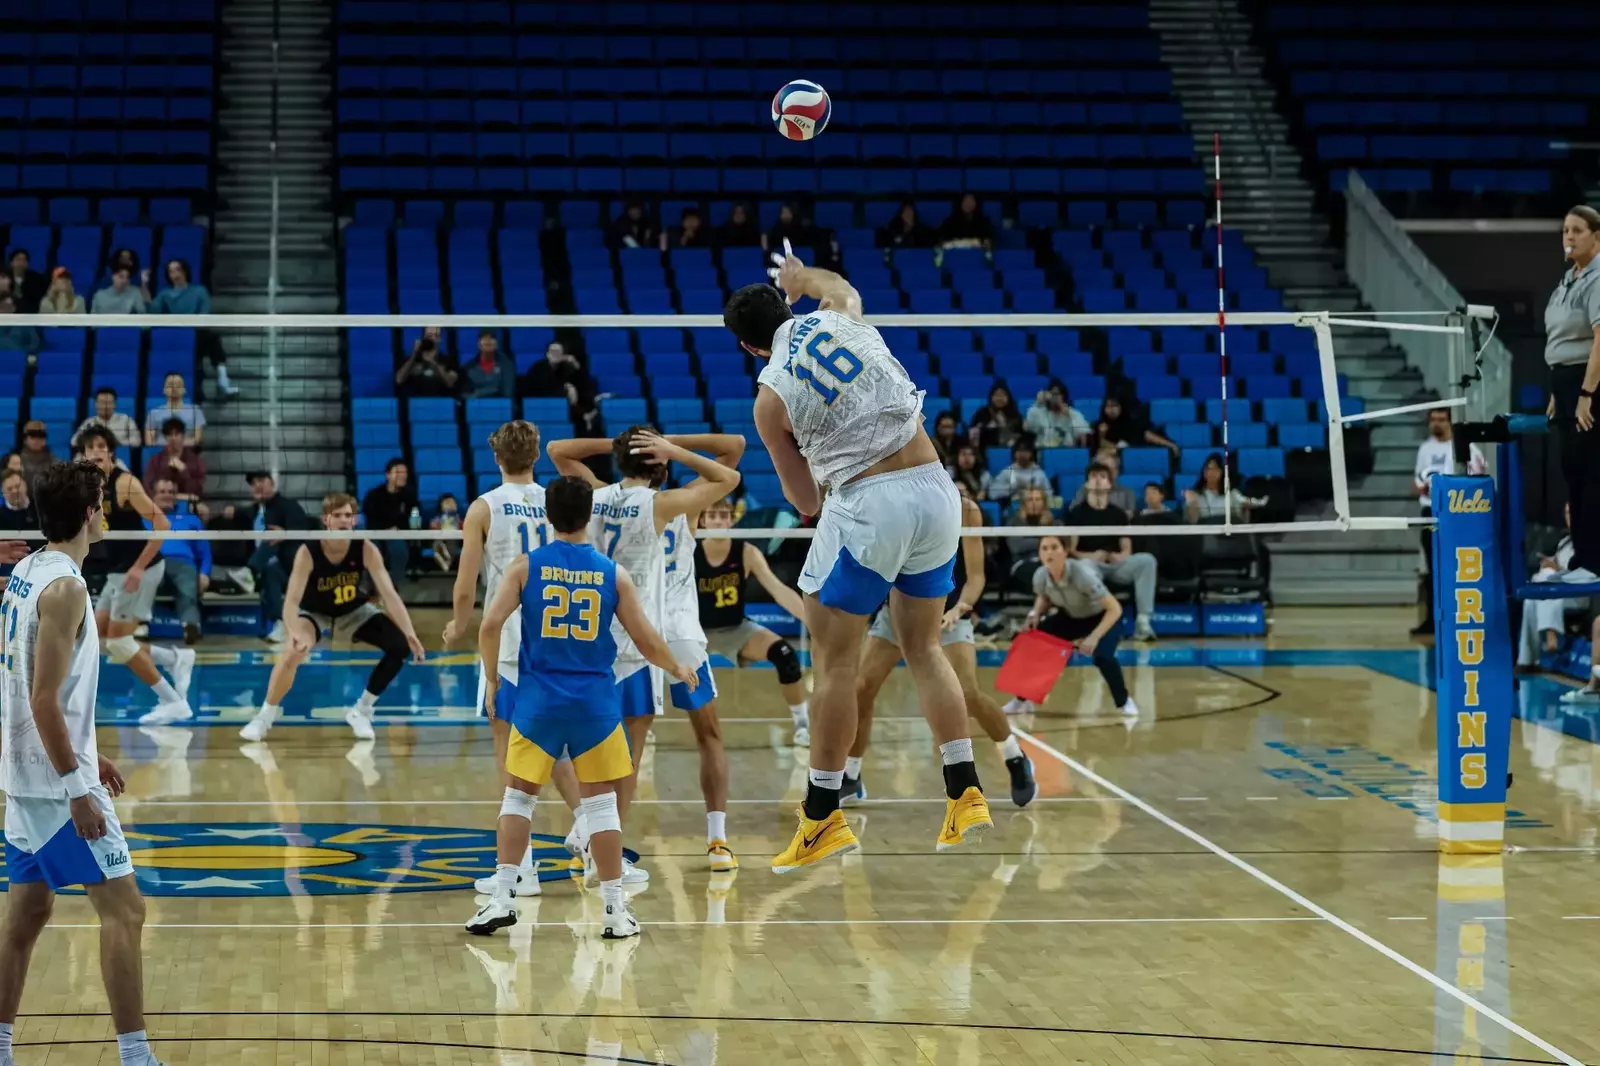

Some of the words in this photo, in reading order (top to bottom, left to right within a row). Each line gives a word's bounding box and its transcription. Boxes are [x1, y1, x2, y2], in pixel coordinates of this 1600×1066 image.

[793, 330, 865, 408] 16
[502, 503, 547, 519] BRUIN
[592, 503, 640, 519] BRUINS
[516, 521, 548, 555] 11
[603, 521, 622, 561] 7
[540, 565, 604, 586] BRUINS
[334, 584, 356, 605] 10
[714, 586, 738, 608] 13
[540, 584, 602, 642] 23
[1455, 546, 1487, 789] BRUINS
